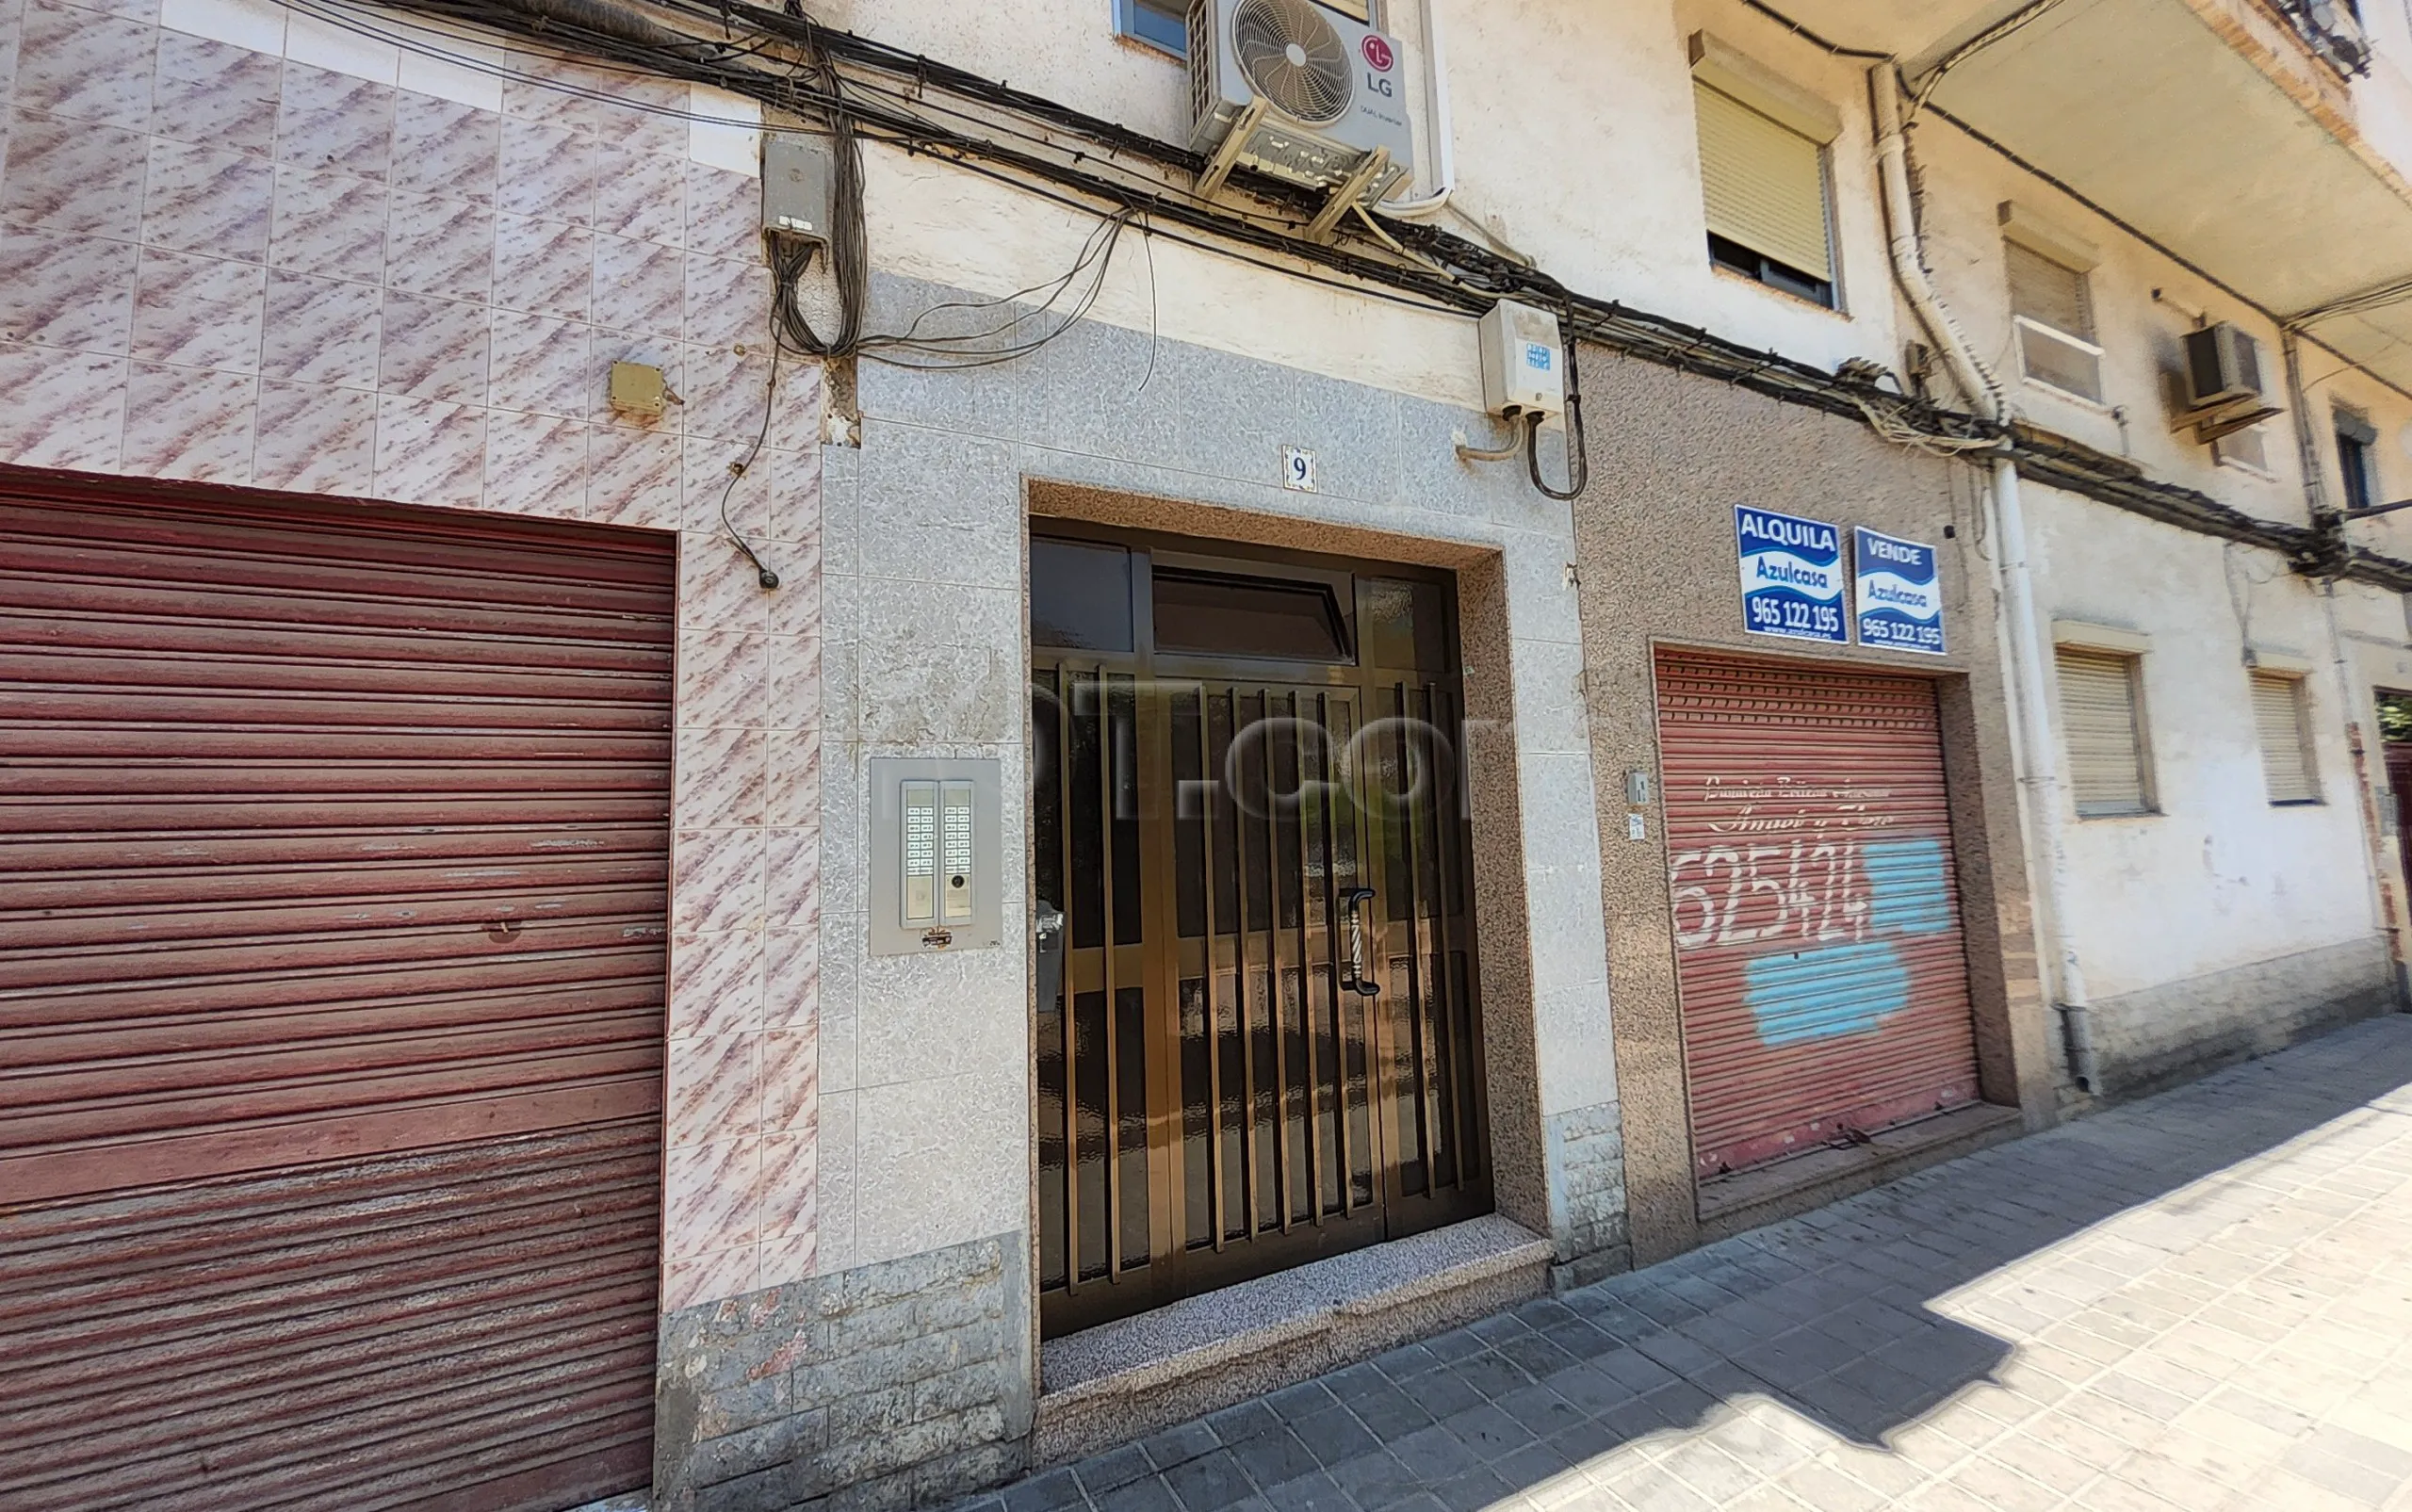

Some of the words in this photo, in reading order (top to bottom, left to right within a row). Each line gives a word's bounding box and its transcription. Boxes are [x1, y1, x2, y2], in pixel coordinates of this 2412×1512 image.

[1366, 72, 1393, 98] LG
[1294, 457, 1307, 481] 9
[1740, 513, 1836, 552] ALQUILA
[1866, 537, 1923, 566] VENDE
[1755, 556, 1829, 589] Azulcasa
[1867, 578, 1929, 608] Azulcasa
[1752, 596, 1782, 626] 965
[1783, 602, 1812, 630] 122
[1812, 604, 1839, 632] 195
[1862, 617, 1889, 639] 965
[1890, 622, 1916, 642] 122
[1917, 626, 1941, 645] 195
